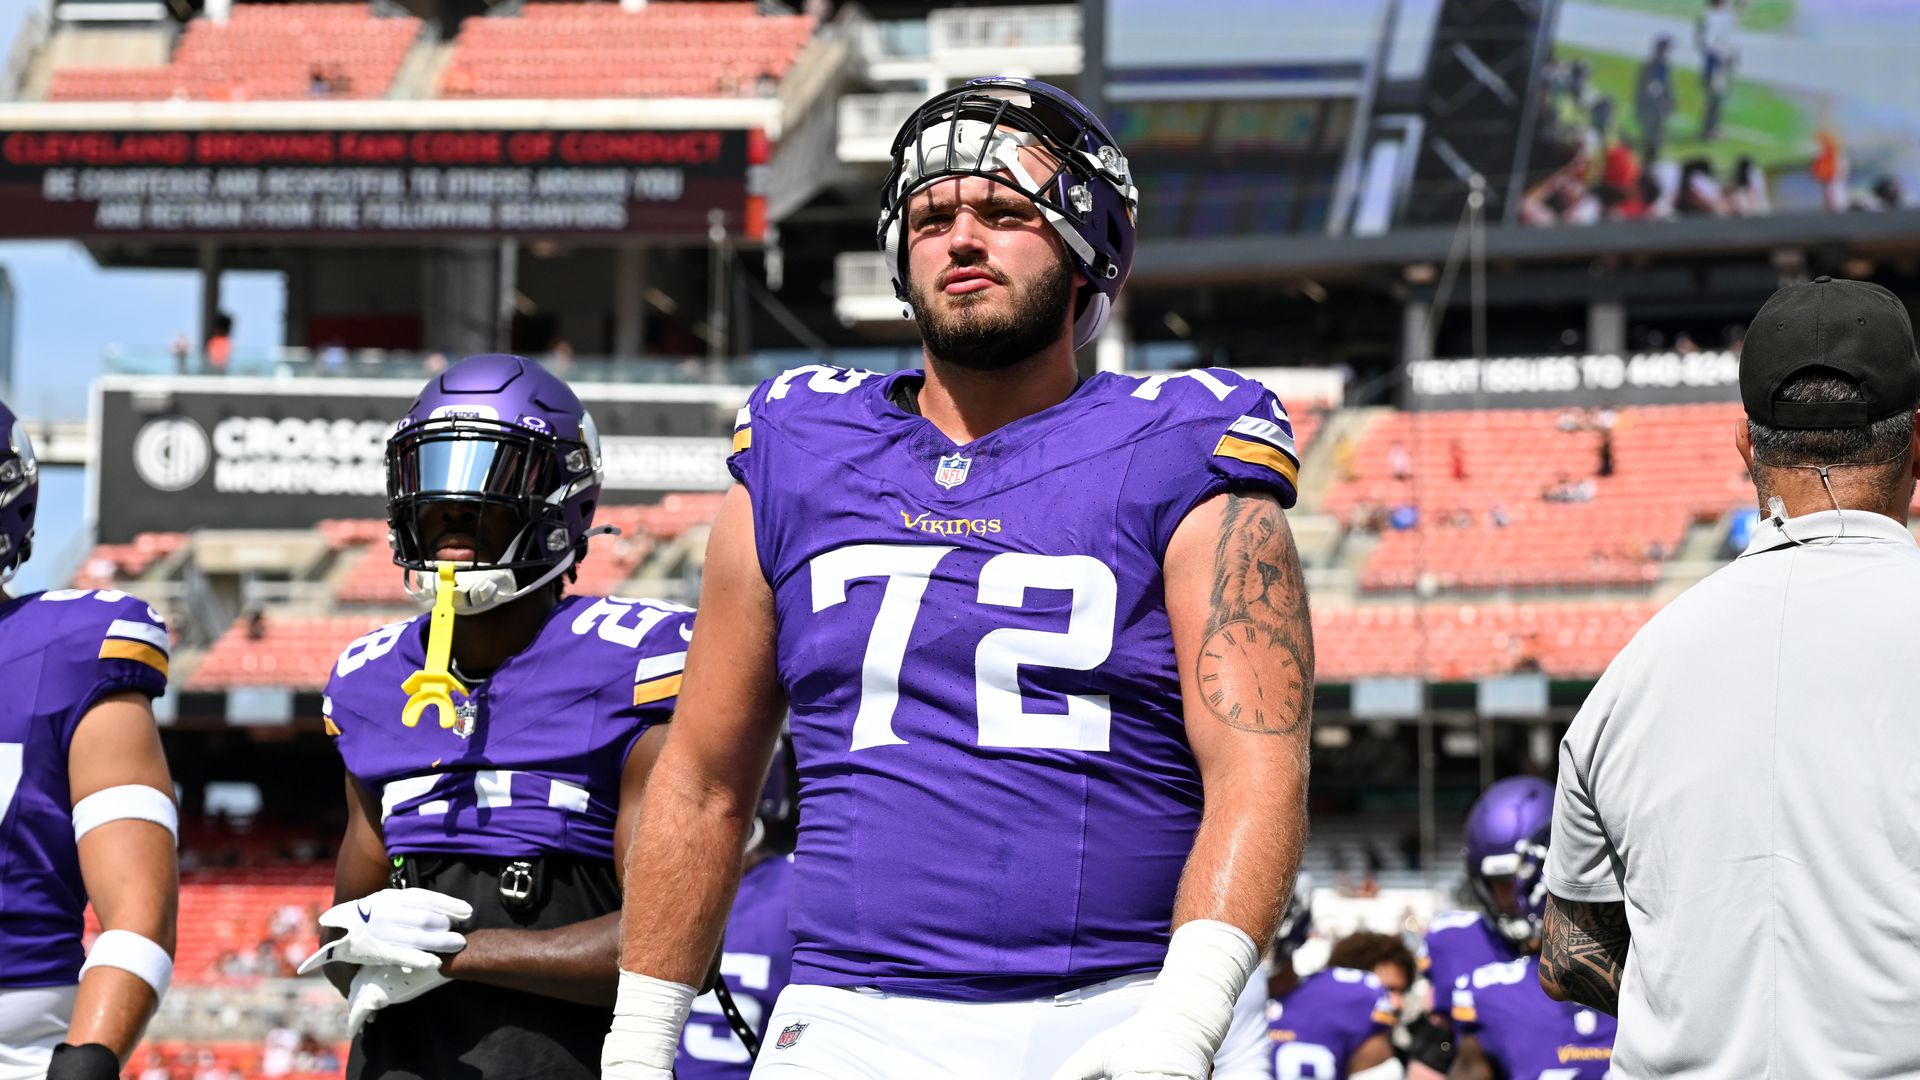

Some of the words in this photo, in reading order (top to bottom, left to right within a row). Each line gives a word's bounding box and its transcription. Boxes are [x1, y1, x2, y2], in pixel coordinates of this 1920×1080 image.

[4, 132, 190, 165] CLEVELAND
[197, 132, 334, 165] BROWNS
[340, 132, 406, 165] FAN
[411, 132, 500, 165] CODE
[508, 132, 553, 165] OF
[560, 132, 722, 165] CONDUCT
[43, 168, 77, 199] BE
[410, 168, 441, 199] TO
[632, 168, 685, 199] YOU
[1408, 359, 1479, 395] TEXT
[1481, 356, 1579, 393] ISSUES
[1580, 354, 1625, 390] TO
[213, 417, 392, 459] CROSSC
[213, 459, 389, 494] MORTGAG
[940, 469, 963, 481] NFL
[810, 545, 1117, 752] 72
